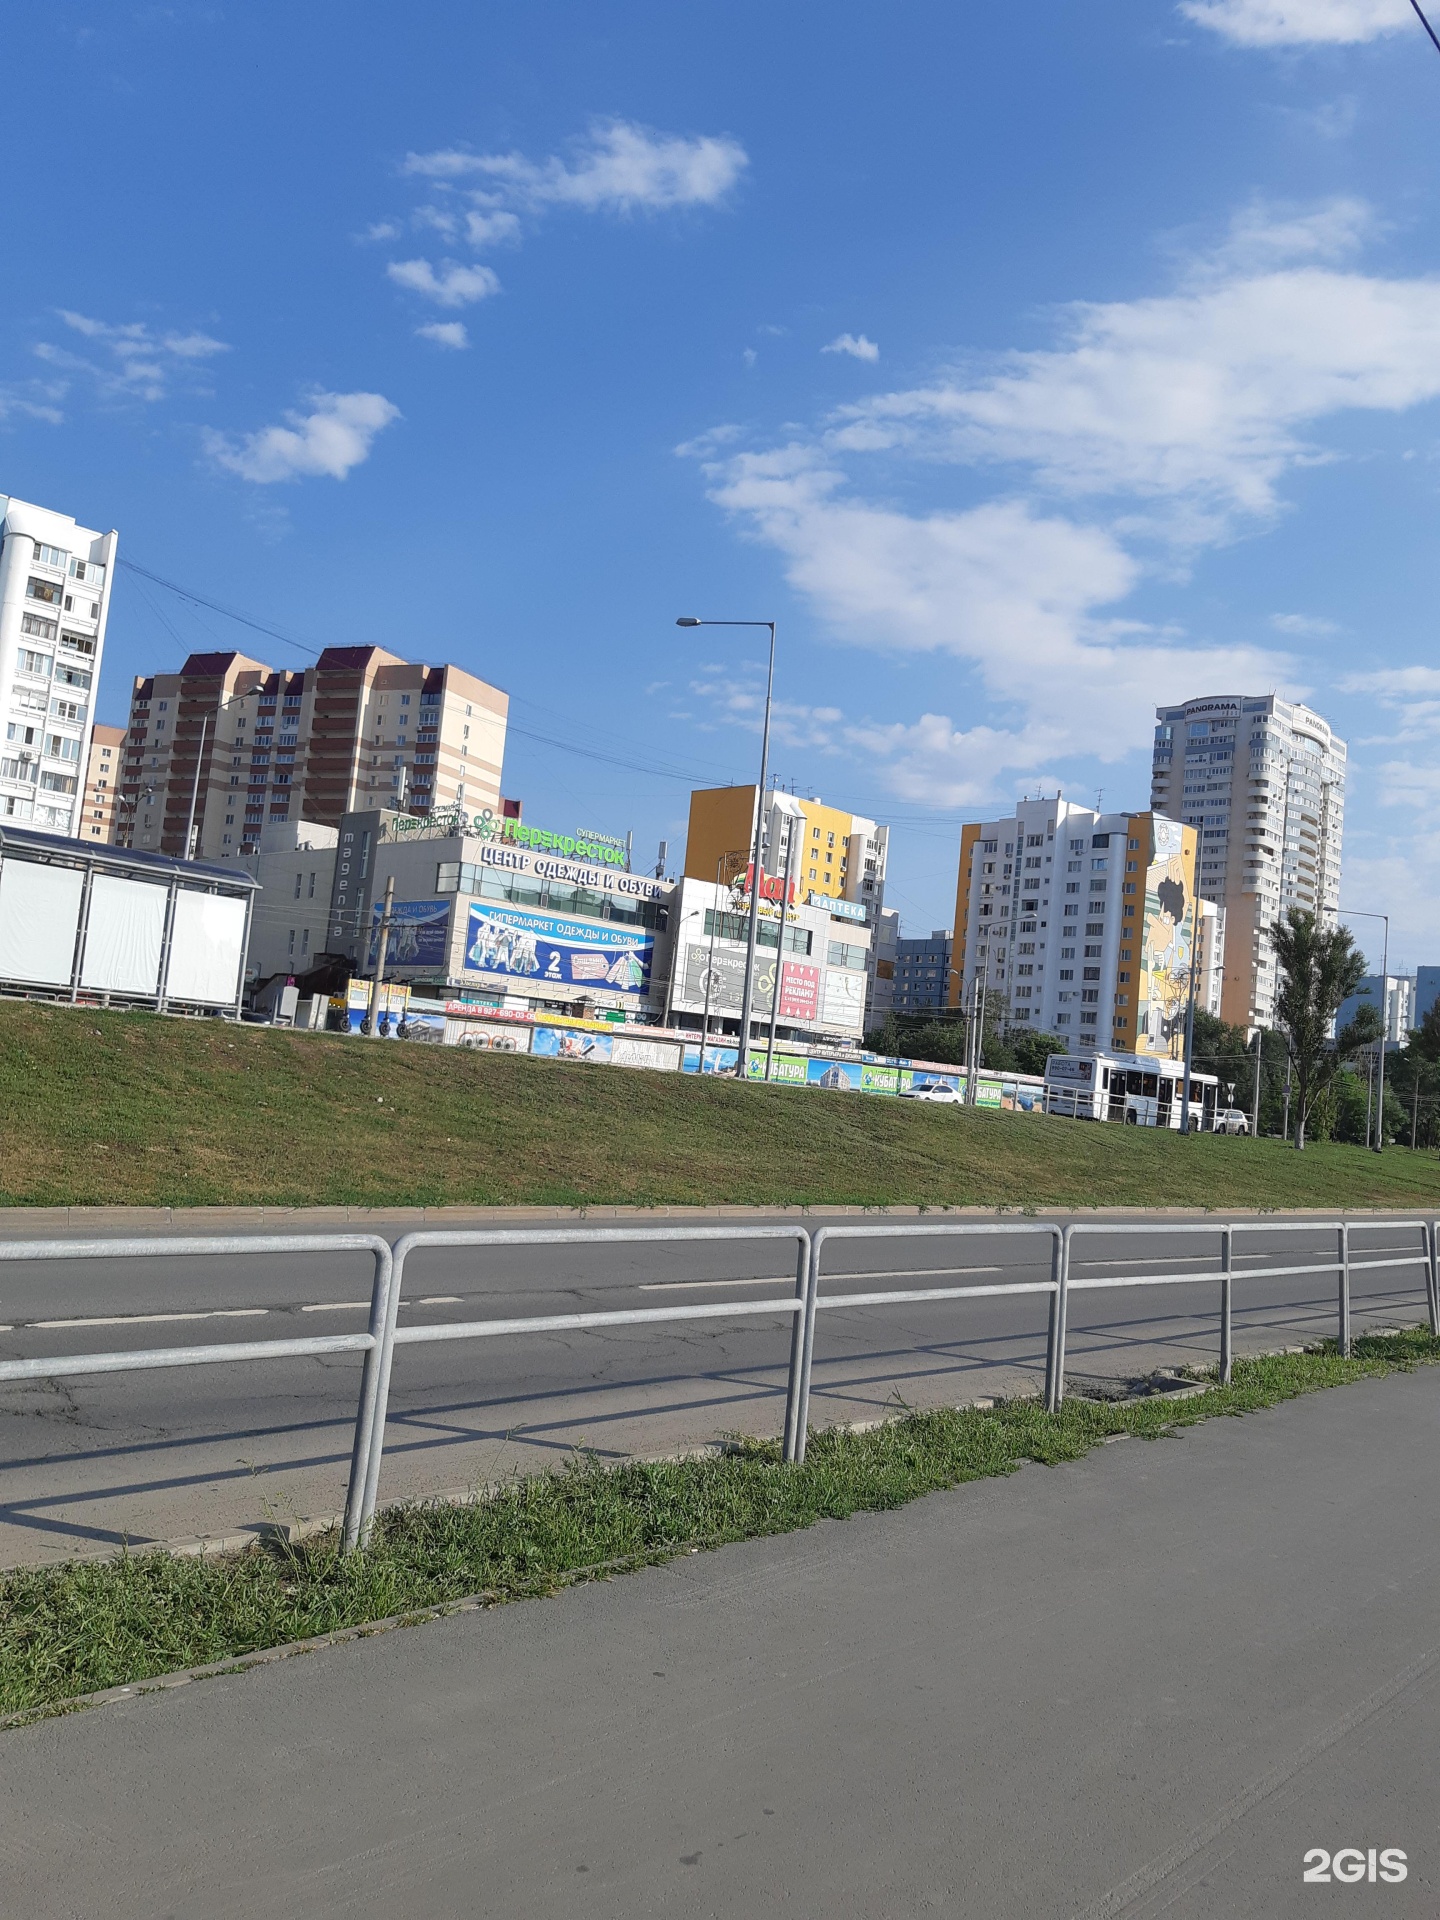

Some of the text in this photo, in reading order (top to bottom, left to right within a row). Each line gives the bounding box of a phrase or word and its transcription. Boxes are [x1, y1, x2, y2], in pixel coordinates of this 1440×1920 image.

[1186, 702, 1237, 715] PANORAMA
[504, 817, 625, 866] Перекресток
[575, 827, 626, 848] СУПЕРМАРКЕТ
[481, 847, 663, 899] ЦЕНТР ОДЕЖДЫ И ОБУВИ
[822, 901, 864, 918] АПТЕКА
[489, 911, 639, 947] ГИПЕРМАРКЕТ ОДЕЖДЫ И ОБУВИ
[547, 950, 561, 971] 2
[784, 986, 814, 998] РЕКЛАМУ
[785, 976, 815, 989] МЕСТО ПОД
[447, 1003, 477, 1014] АРЕНДА
